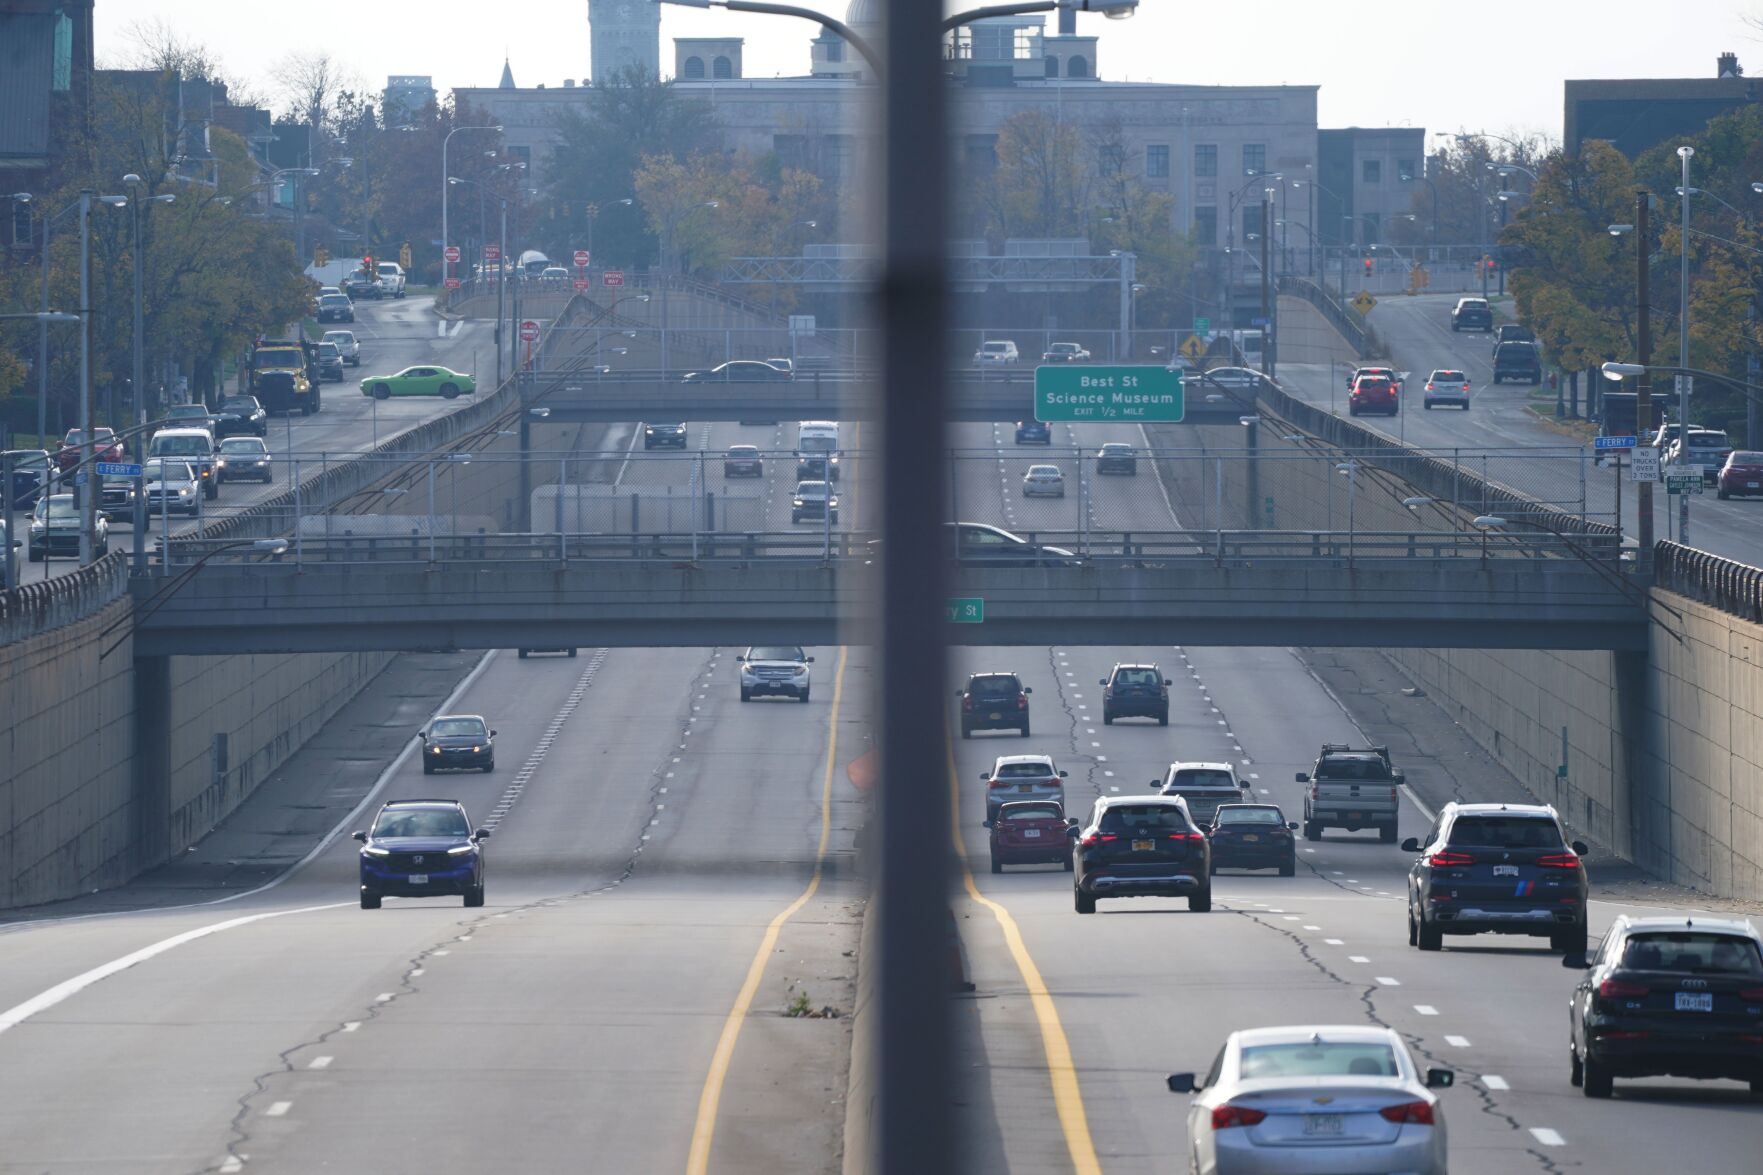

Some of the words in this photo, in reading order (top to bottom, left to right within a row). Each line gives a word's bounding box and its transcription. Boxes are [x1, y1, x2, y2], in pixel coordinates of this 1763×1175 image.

[1080, 376, 1114, 387] Best
[1122, 376, 1138, 387] St
[1046, 392, 1104, 404] Science
[1112, 392, 1173, 404] Museum
[1074, 407, 1094, 416] EXIT
[1123, 407, 1144, 416] MILE
[1602, 438, 1626, 447] FERRY
[105, 464, 131, 474] FERRY
[966, 605, 977, 616] St
